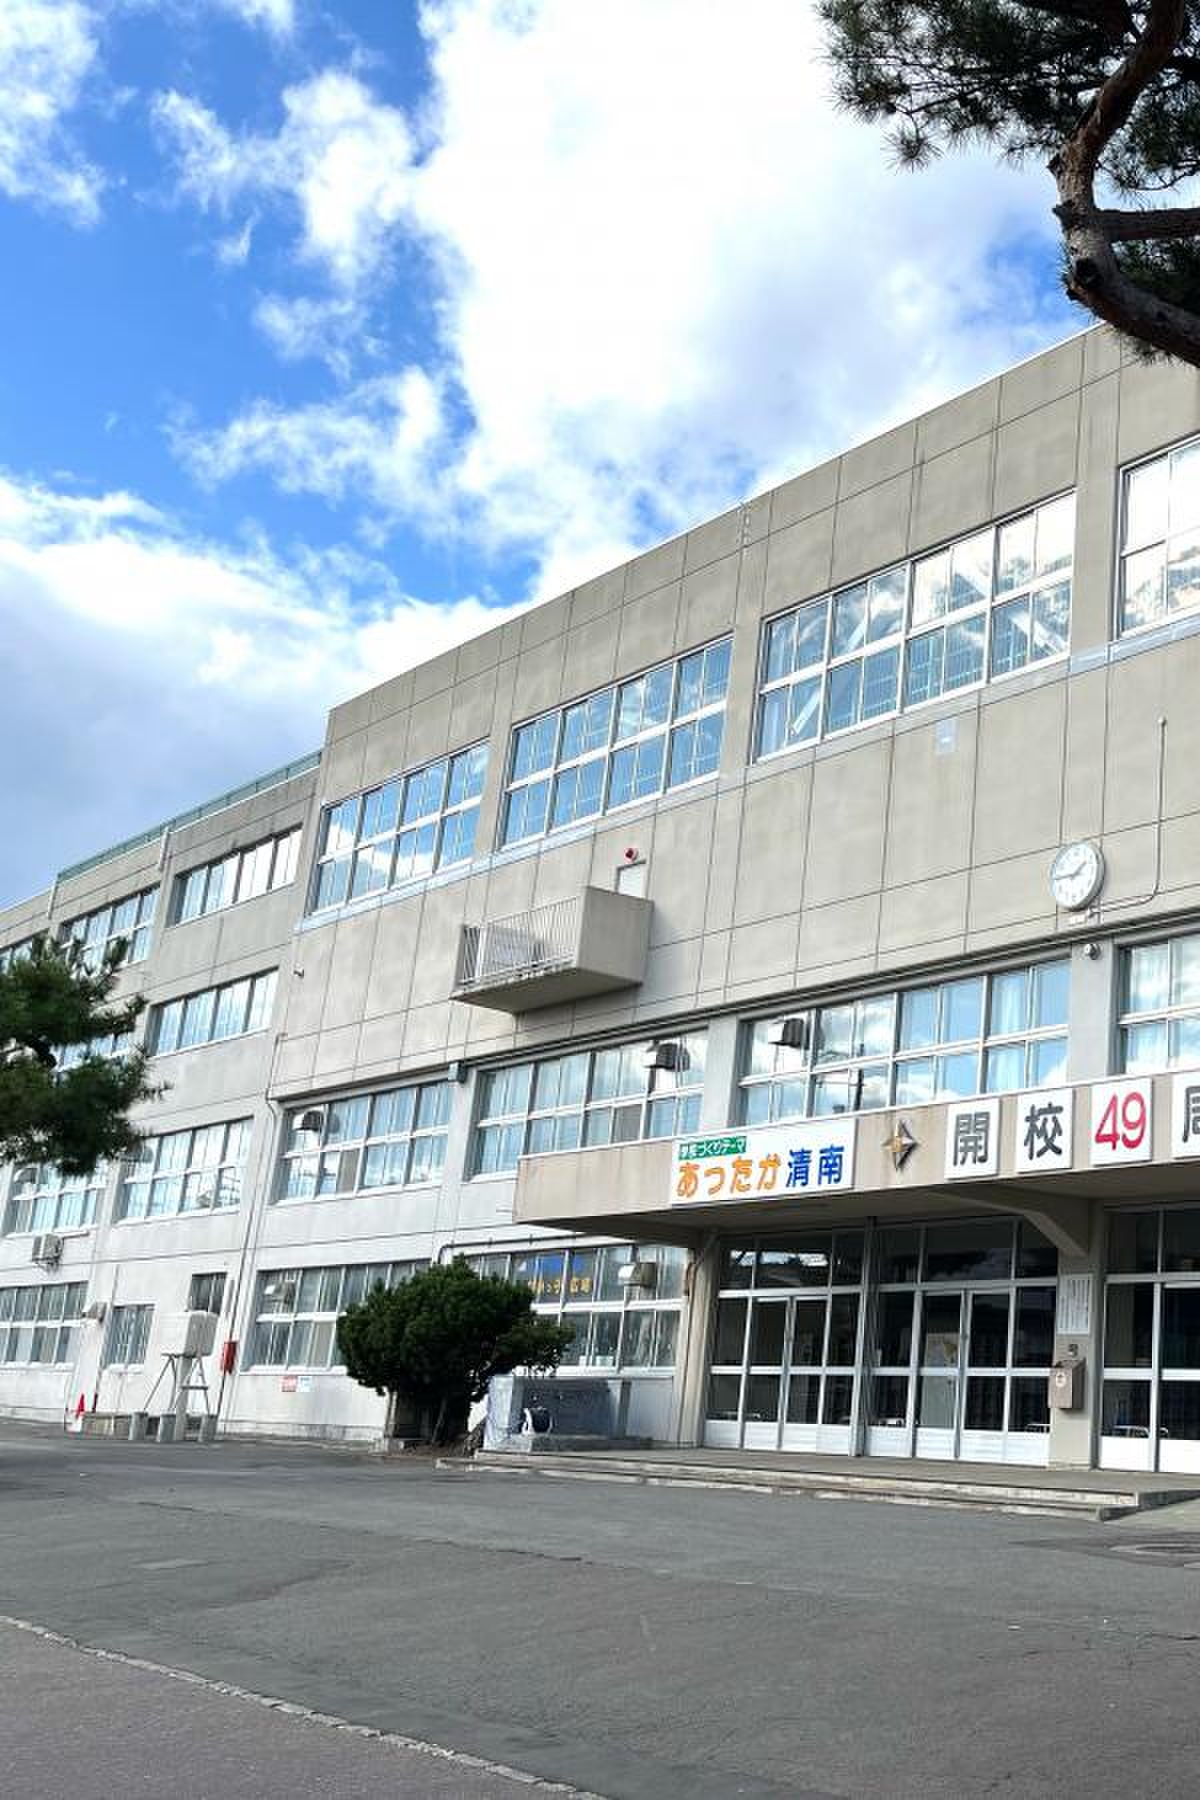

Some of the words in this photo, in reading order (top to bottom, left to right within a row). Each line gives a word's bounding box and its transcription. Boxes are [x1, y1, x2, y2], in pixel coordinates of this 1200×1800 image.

[677, 1144, 845, 1198] あったか清南
